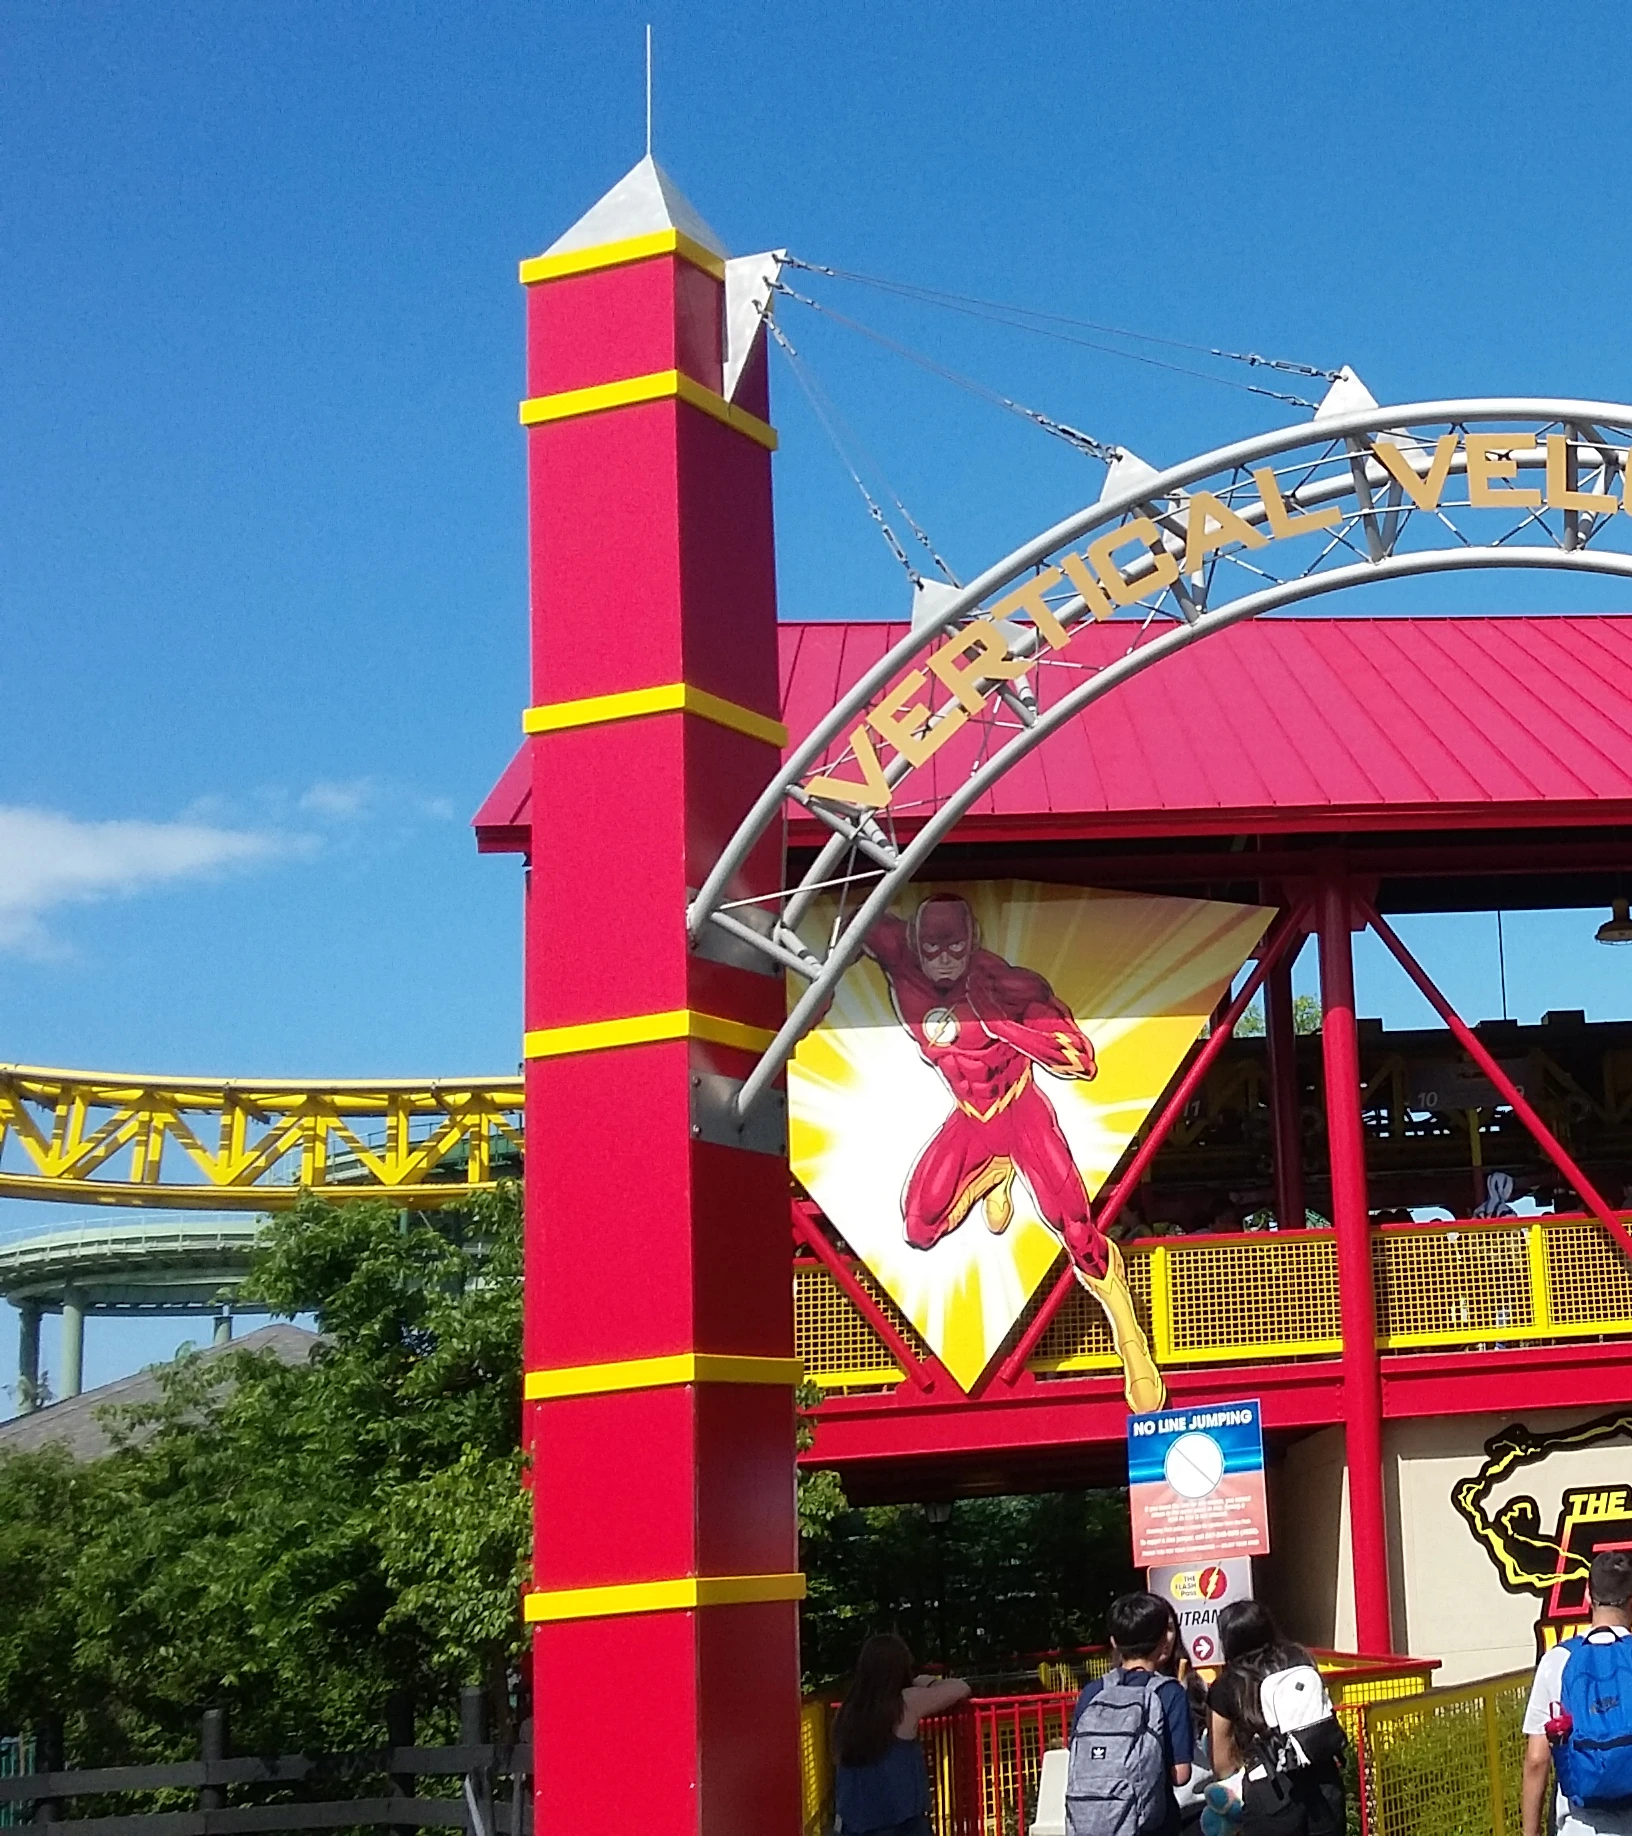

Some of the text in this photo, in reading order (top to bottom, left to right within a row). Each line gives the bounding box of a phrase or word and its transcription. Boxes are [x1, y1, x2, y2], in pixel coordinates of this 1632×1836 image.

[804, 467, 1343, 808] VERTICAL
[1418, 1091, 1438, 1107] 10
[1133, 1409, 1253, 1436] NO LINE JUMPING
[1570, 1490, 1628, 1516] THE
[1175, 1582, 1197, 1590] FLASH
